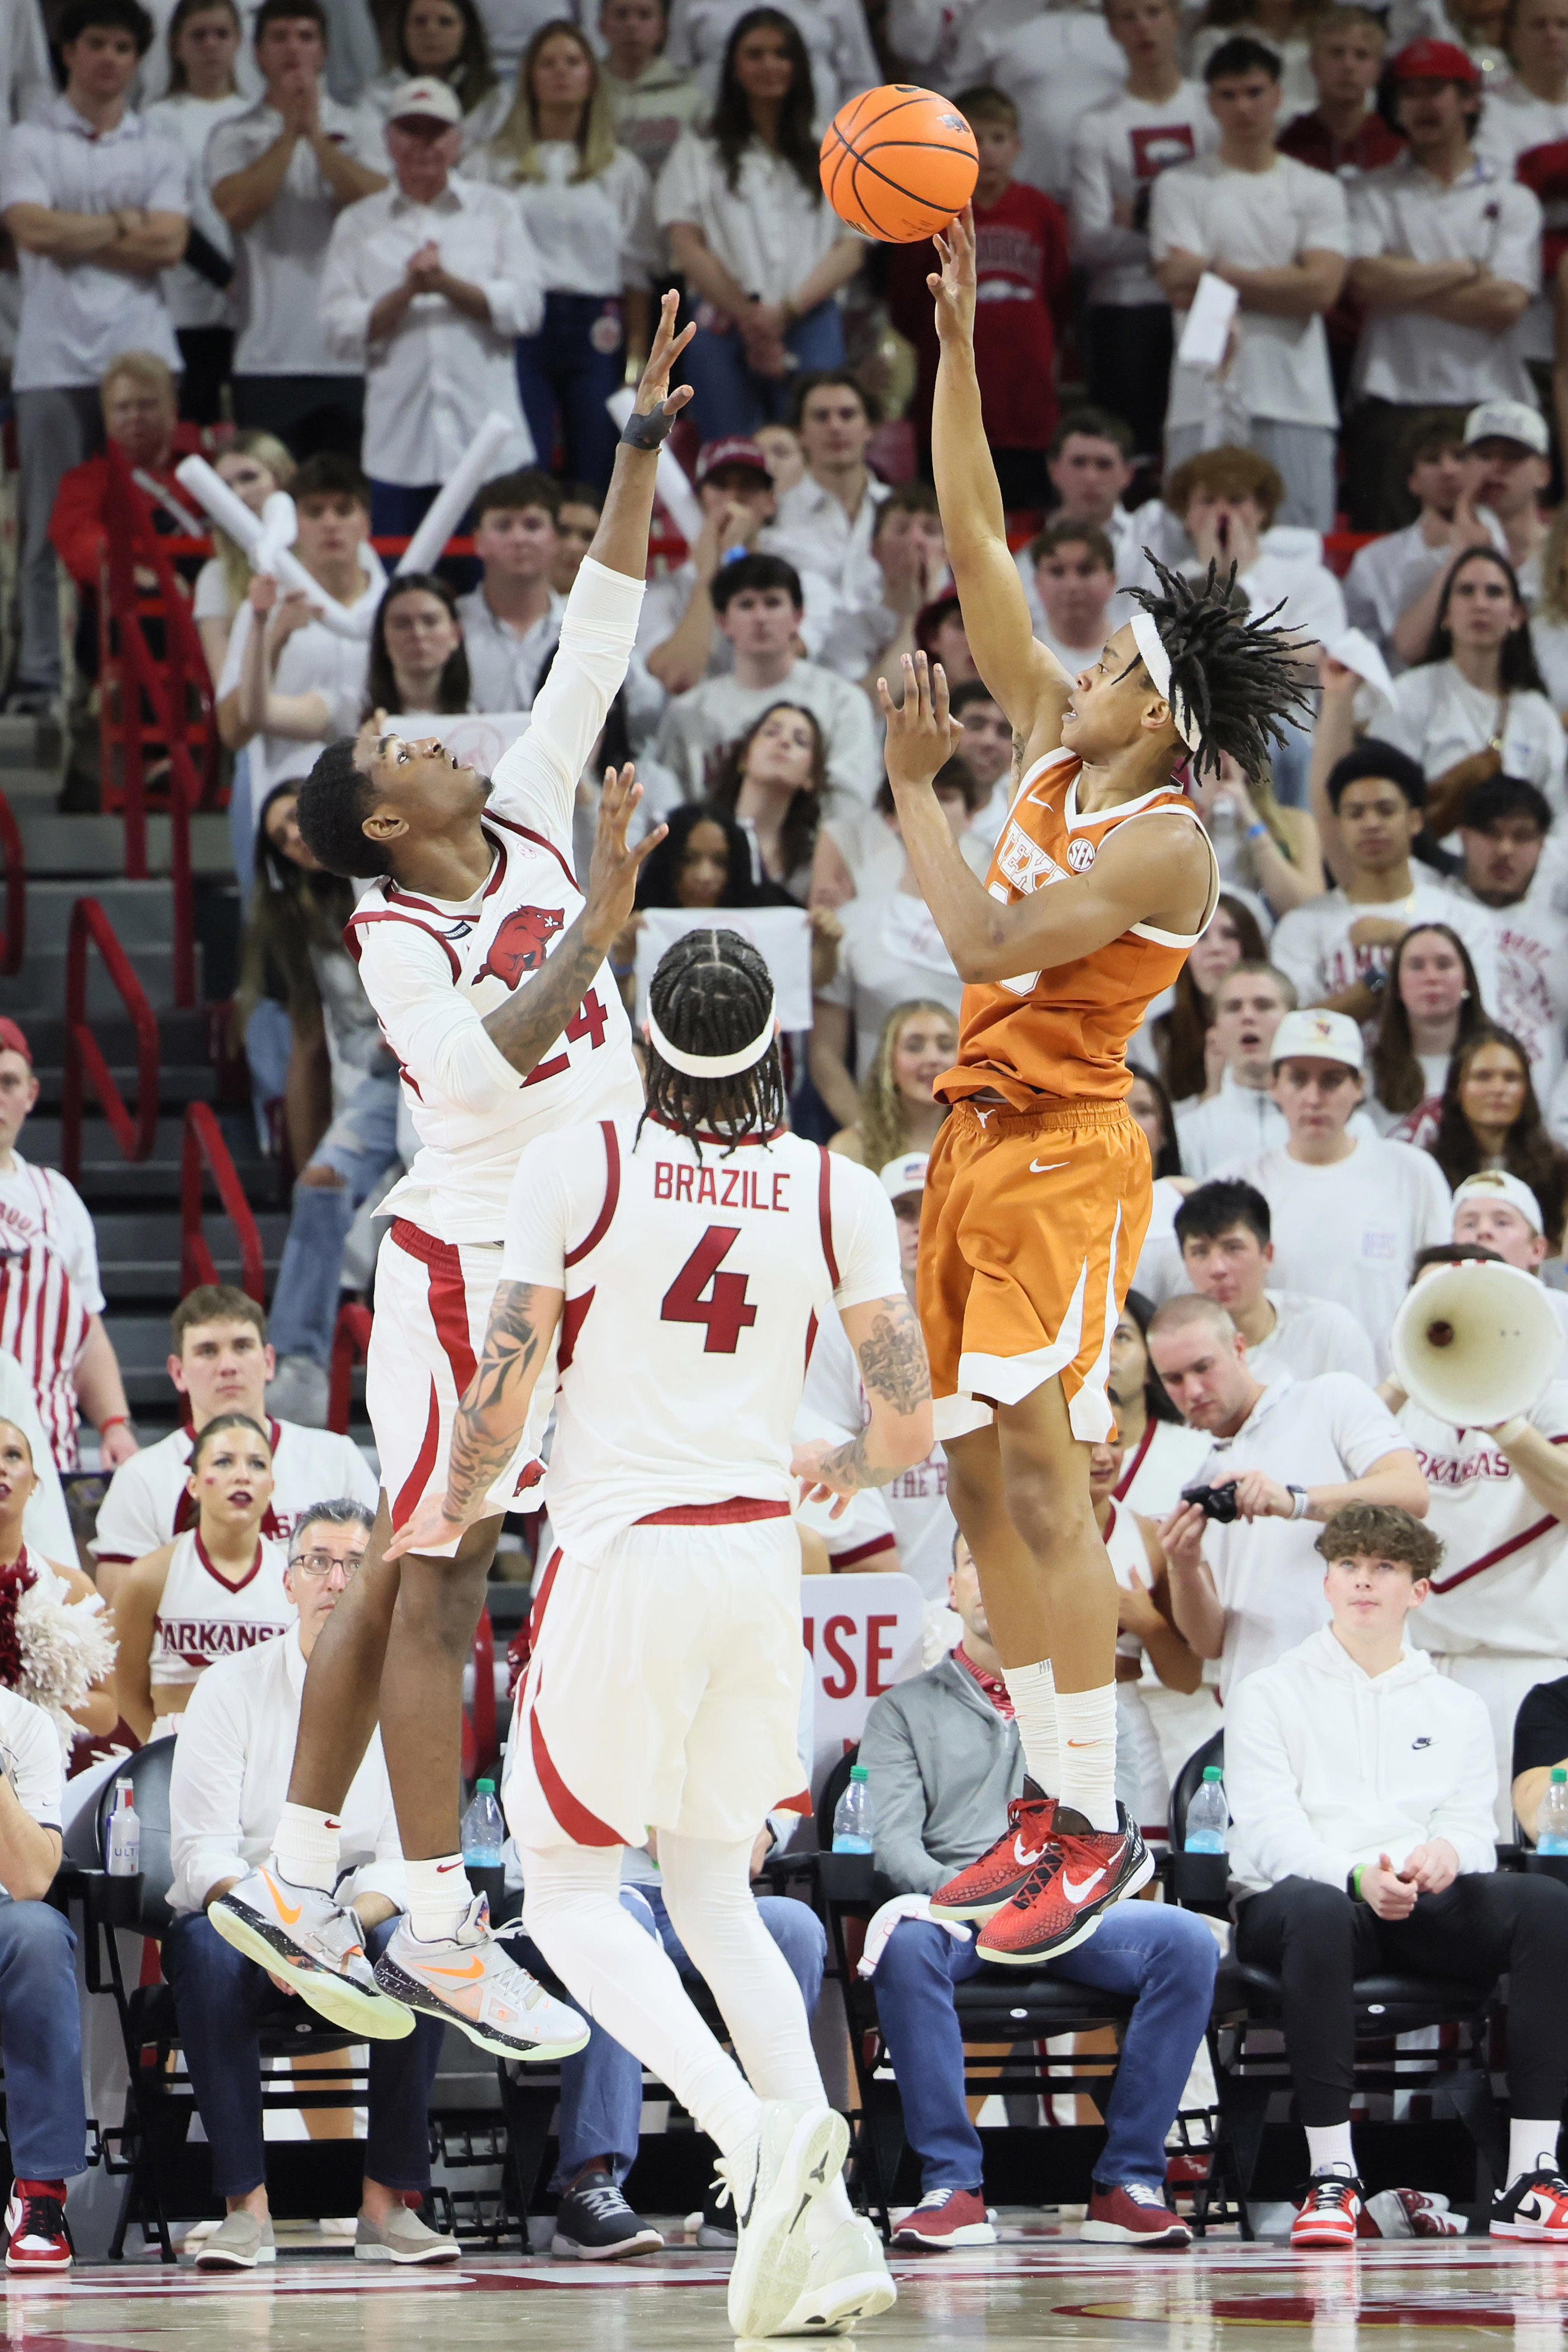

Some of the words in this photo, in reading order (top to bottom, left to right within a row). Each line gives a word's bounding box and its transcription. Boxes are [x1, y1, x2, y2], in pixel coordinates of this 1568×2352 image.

[1068, 839, 1095, 870] SEC
[655, 1162, 790, 1212] BRAZILE
[660, 1225, 758, 1354] 4
[163, 1623, 286, 1651] ARKANS
[115, 1848, 140, 1857] ULT
